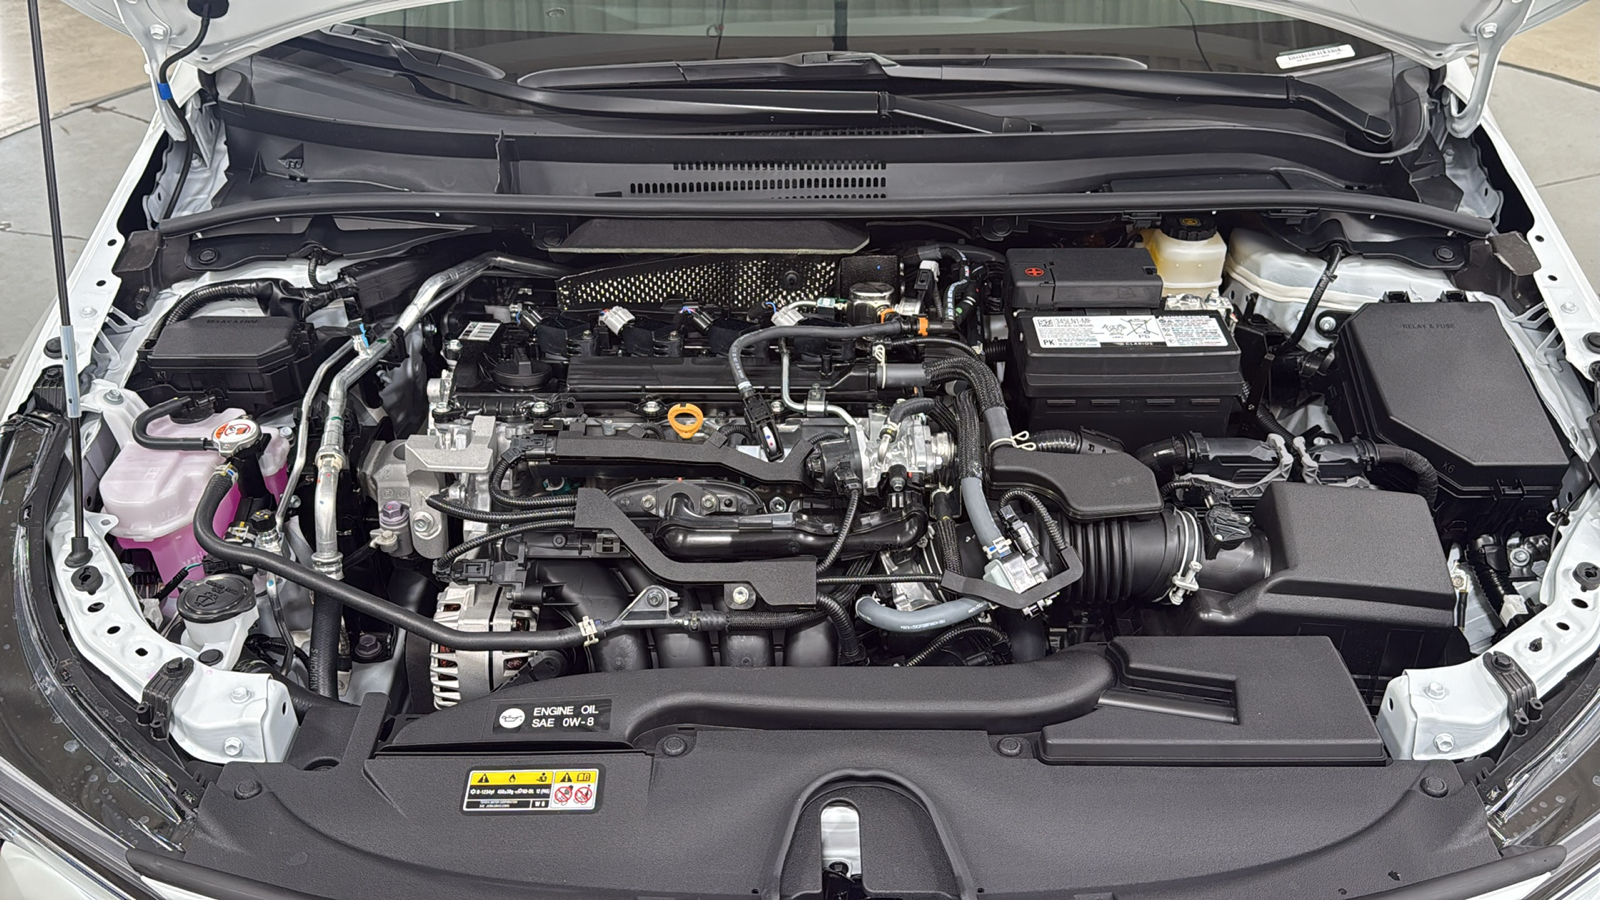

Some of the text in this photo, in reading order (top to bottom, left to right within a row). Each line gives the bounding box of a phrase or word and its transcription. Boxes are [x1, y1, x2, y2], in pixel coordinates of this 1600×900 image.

[1441, 461, 1456, 474] K6
[533, 705, 599, 716] ENGINE OIL
[531, 717, 595, 728] SAE 0W-8
